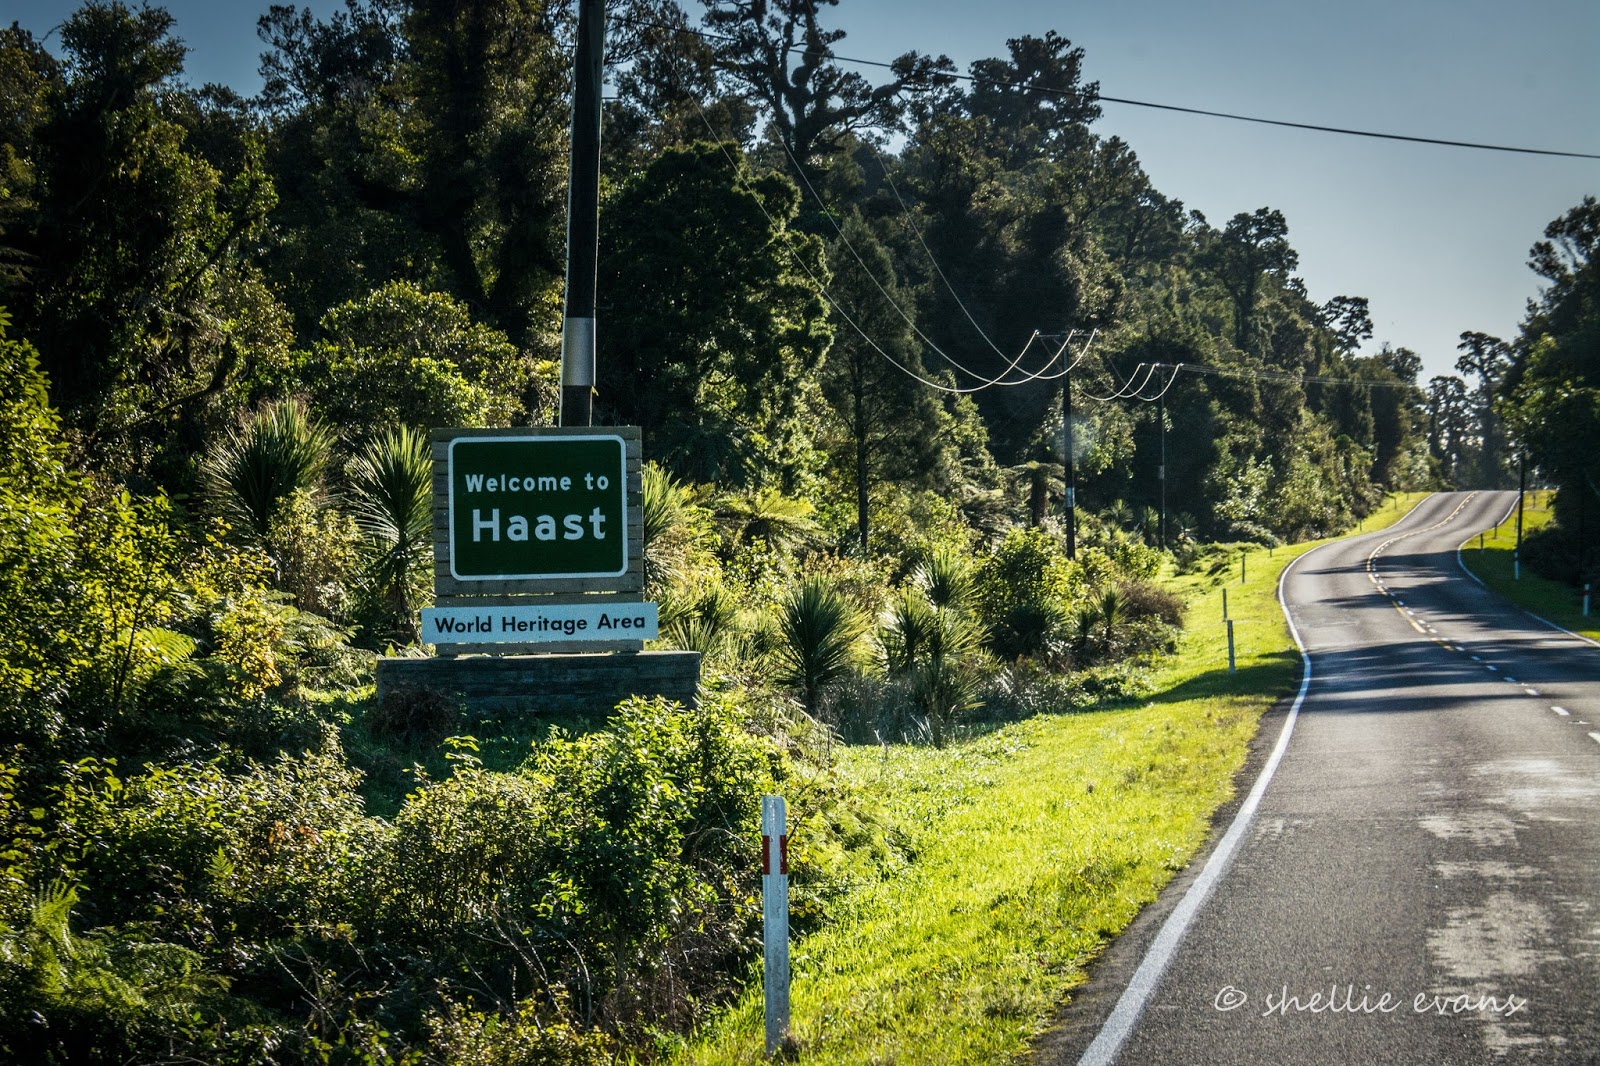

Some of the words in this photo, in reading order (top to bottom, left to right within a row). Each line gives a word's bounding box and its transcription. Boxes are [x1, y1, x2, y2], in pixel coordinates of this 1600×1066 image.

[465, 474, 571, 492] Welcome
[584, 472, 609, 490] to
[472, 506, 606, 542] Haast
[434, 615, 492, 633] World
[501, 615, 588, 635] Heritage
[597, 613, 645, 630] Area
